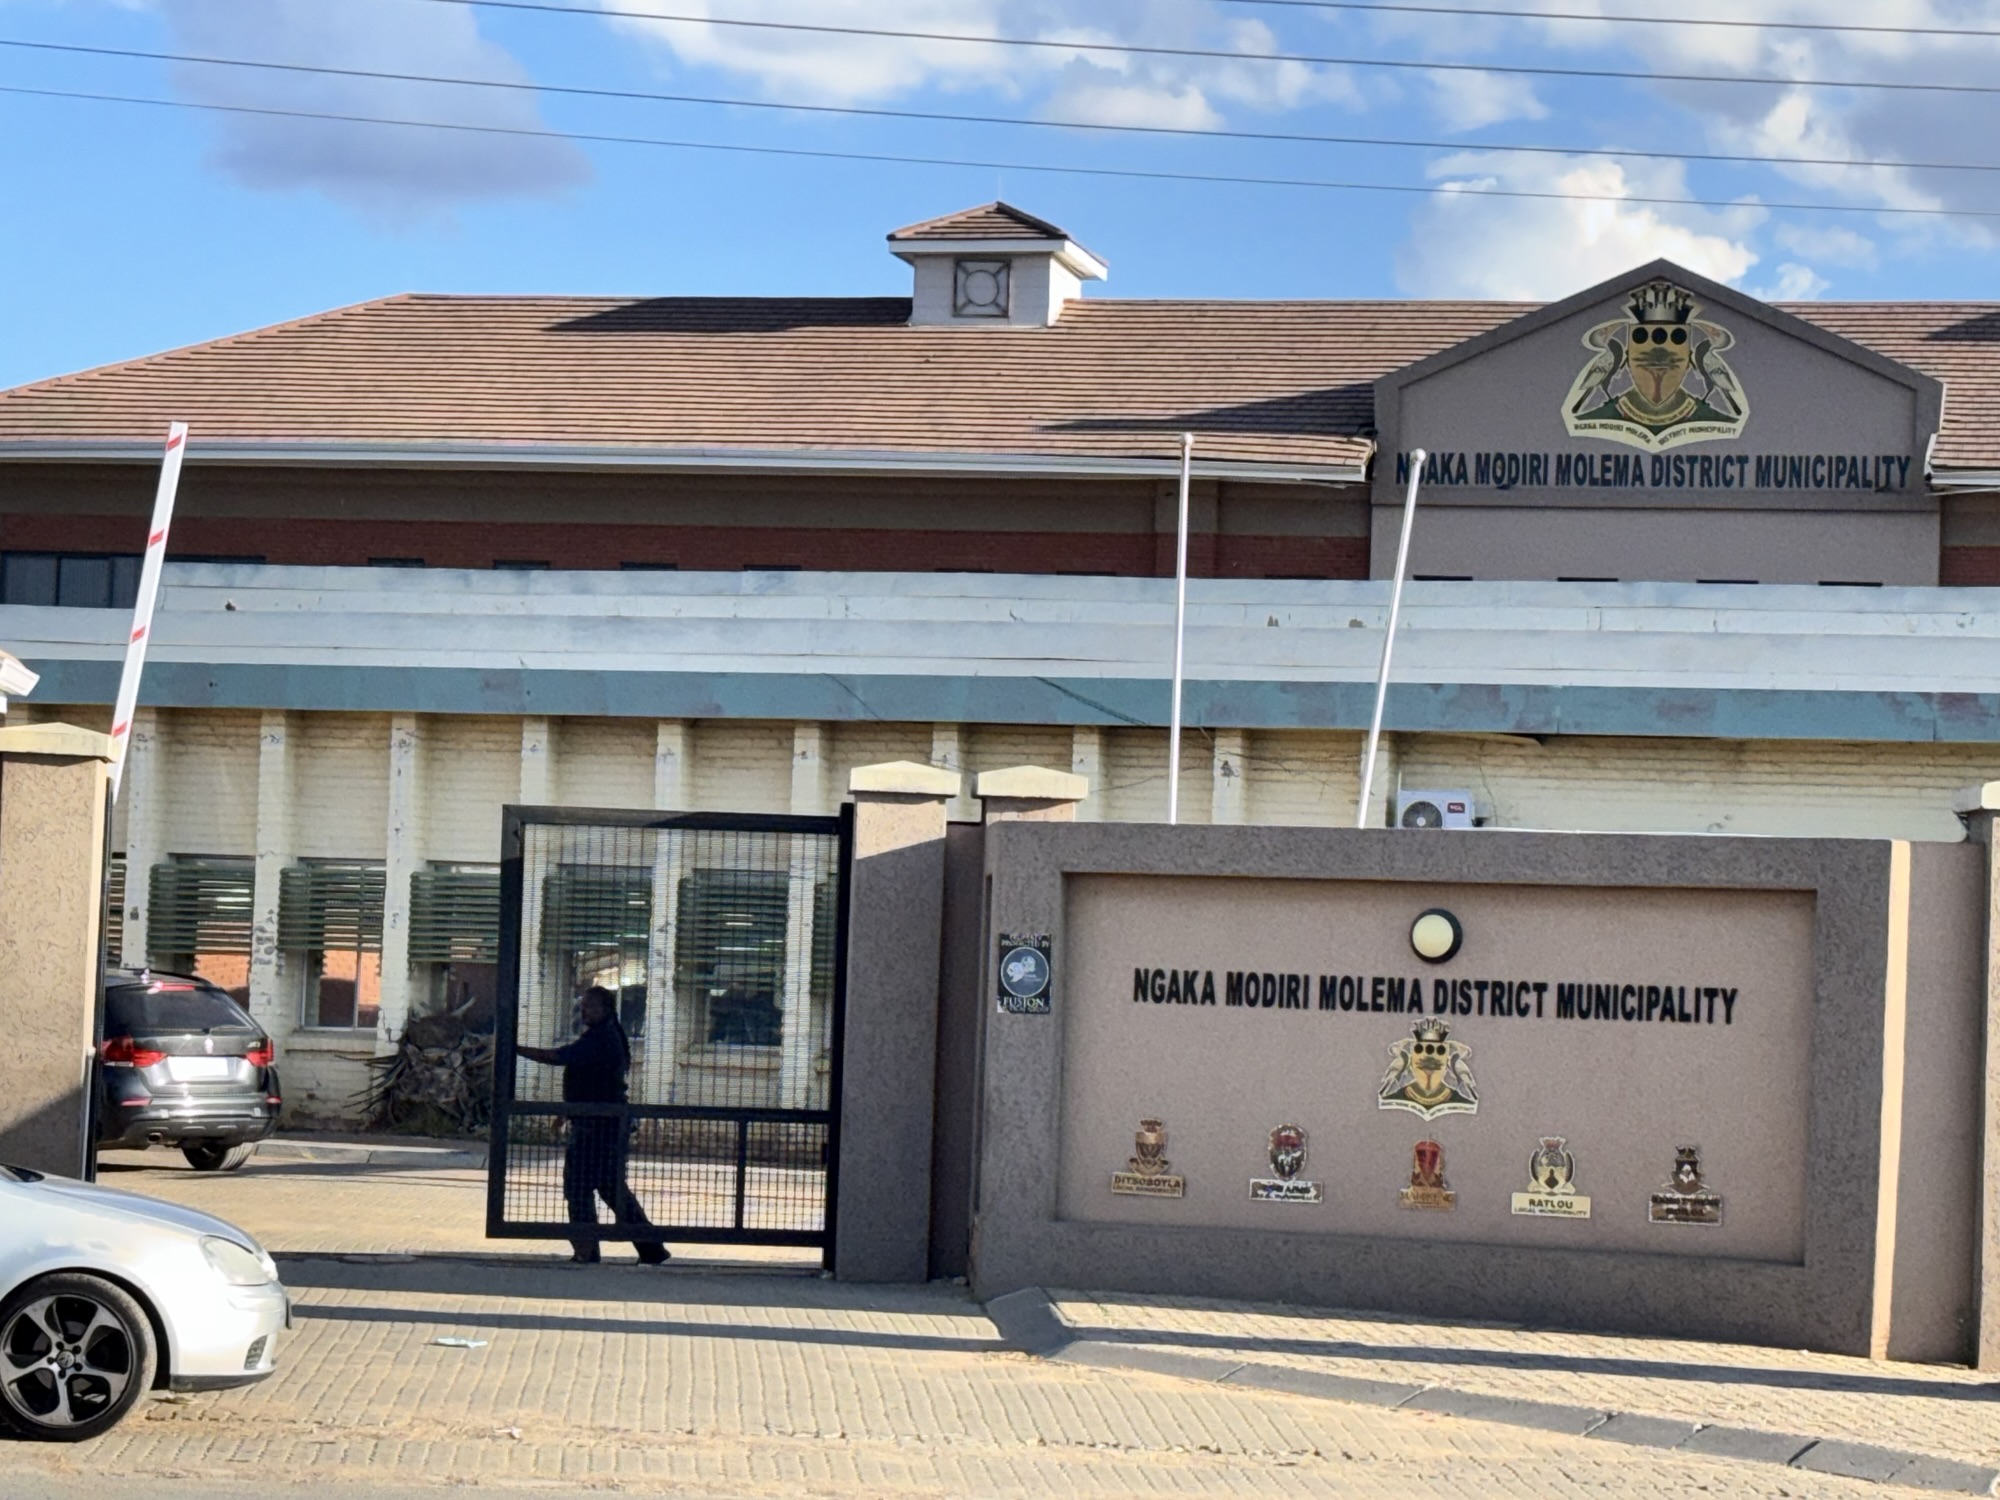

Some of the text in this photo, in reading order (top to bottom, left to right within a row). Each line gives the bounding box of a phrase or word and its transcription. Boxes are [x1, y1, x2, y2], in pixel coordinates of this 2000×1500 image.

[1474, 452, 1548, 487] MODIRI
[1555, 453, 1644, 487] MOLEMA
[1651, 454, 1749, 488] DISTRICT
[1755, 455, 1911, 489] MUNICIPALITY
[1134, 968, 1738, 1024] NGAKA MODIRI MOLEMA DISTRICT MUNICIPALITY
[1528, 1198, 1573, 1209] RATLOU
